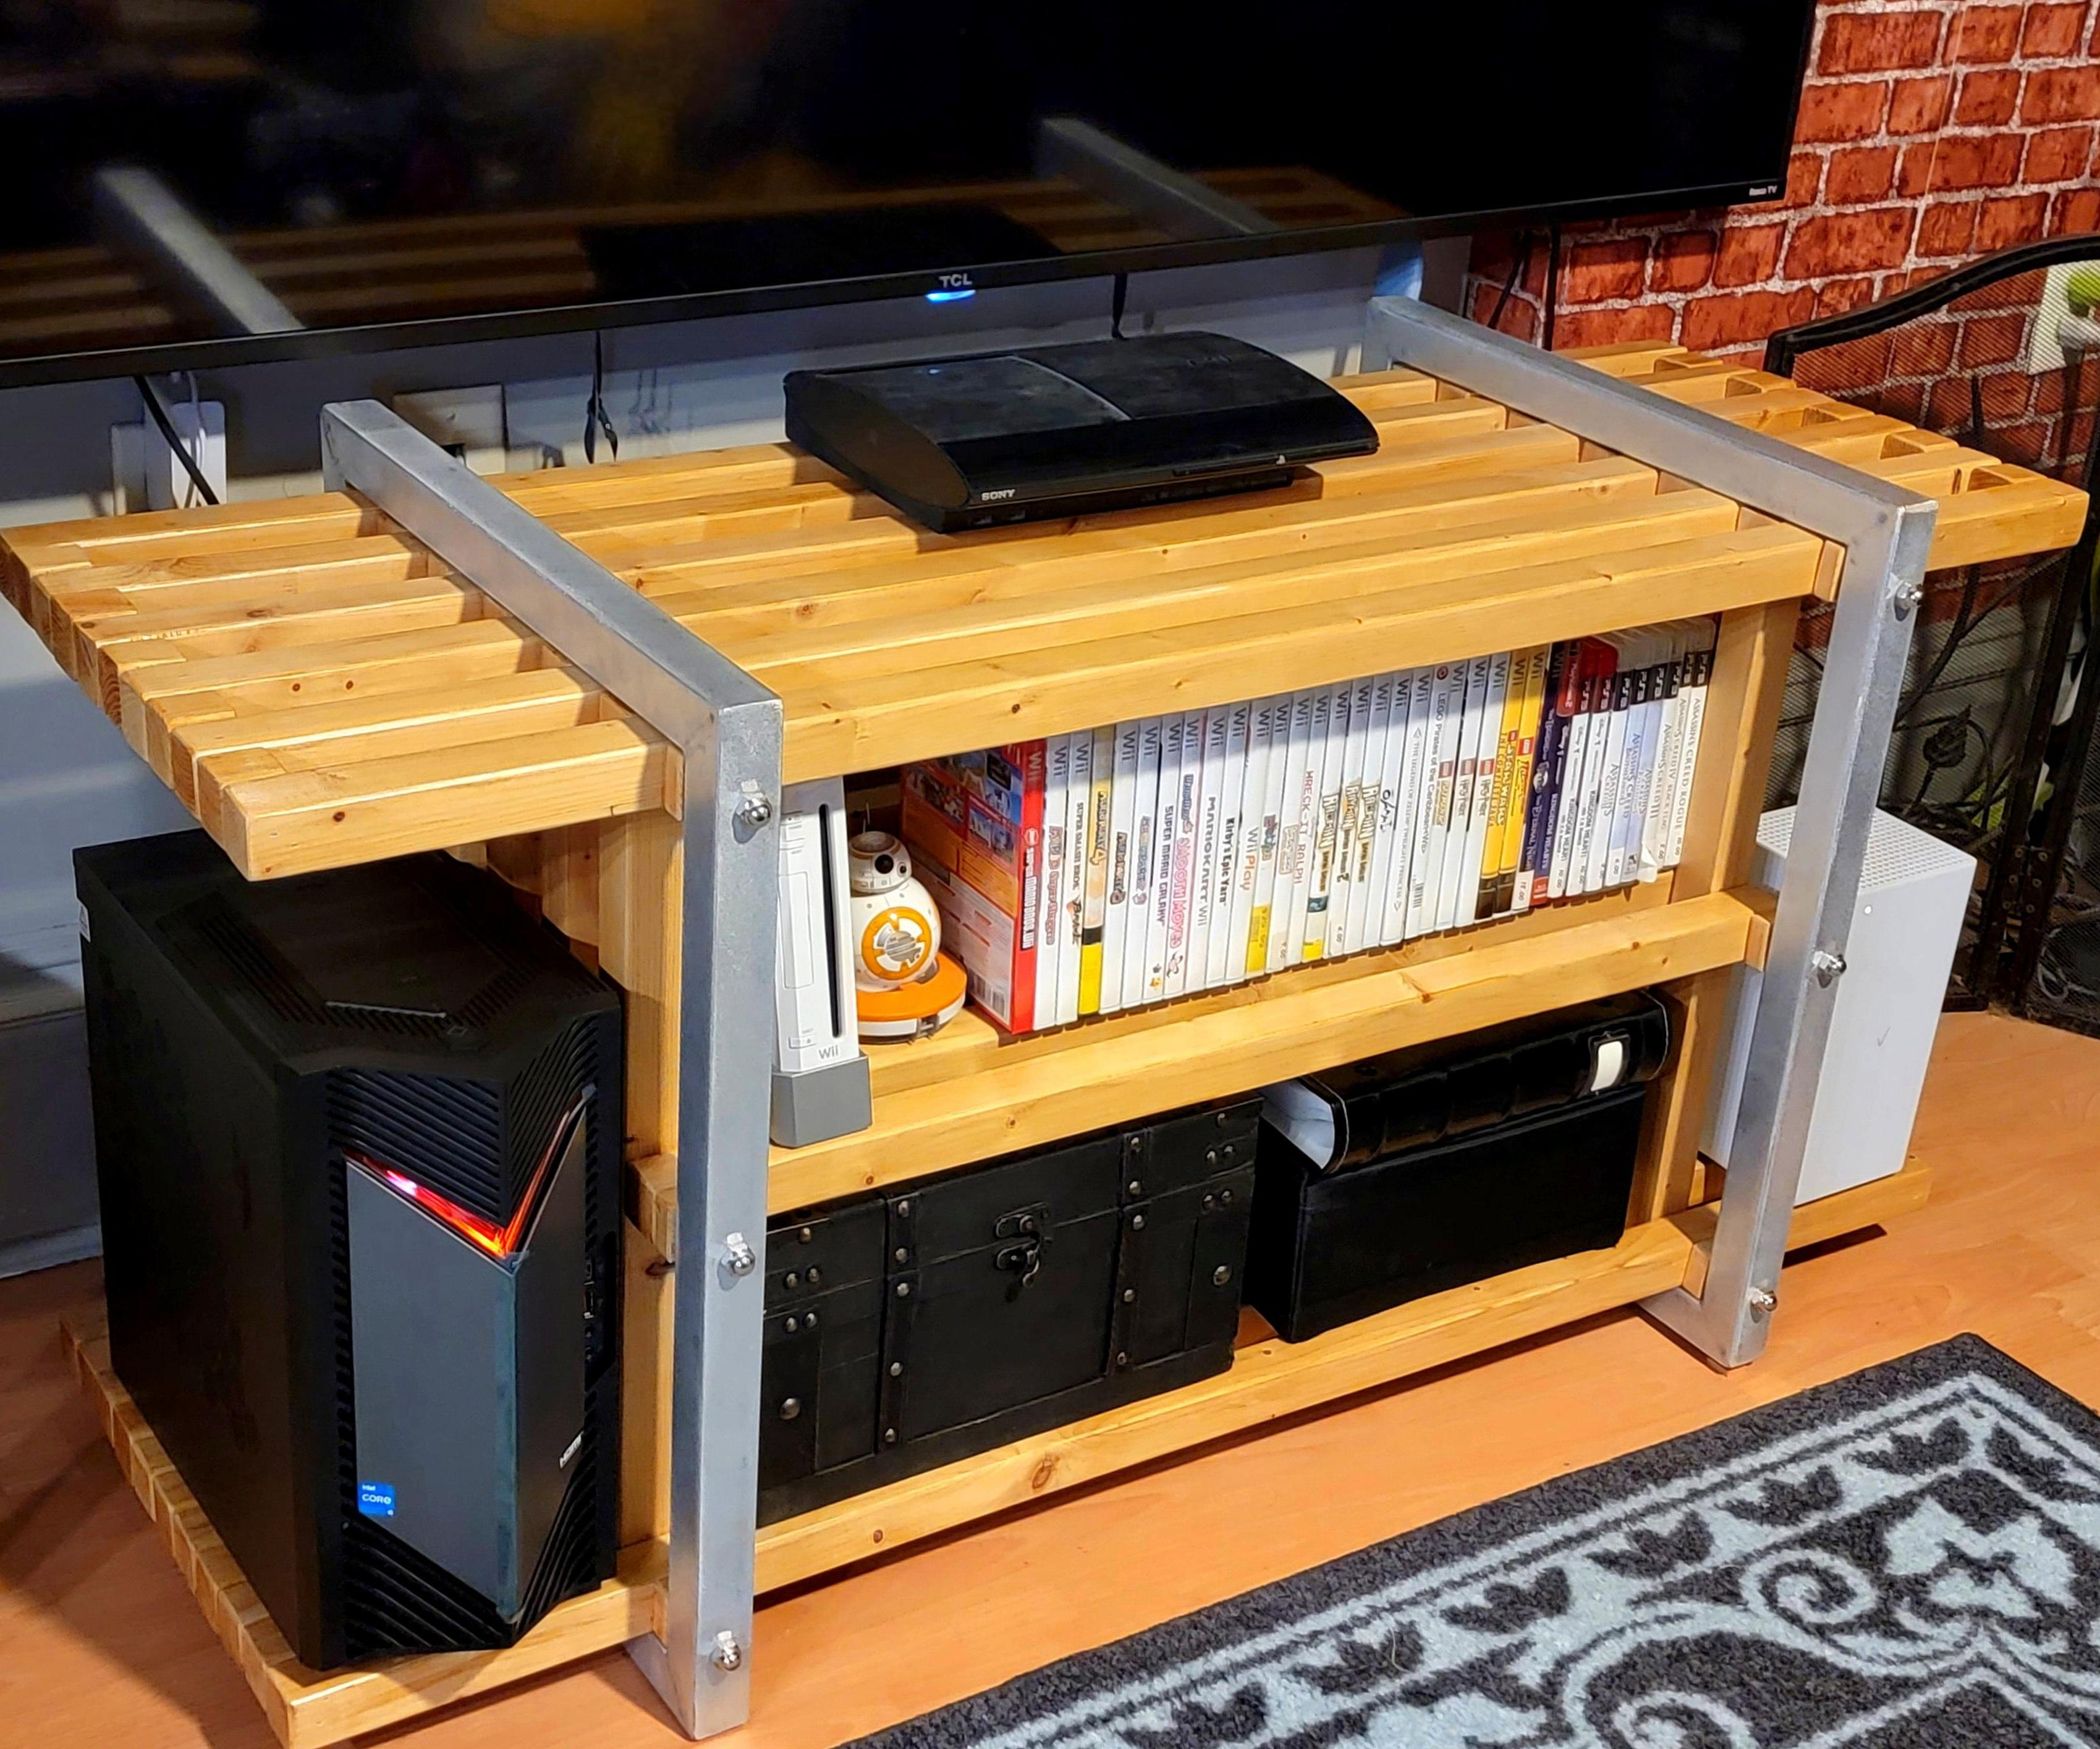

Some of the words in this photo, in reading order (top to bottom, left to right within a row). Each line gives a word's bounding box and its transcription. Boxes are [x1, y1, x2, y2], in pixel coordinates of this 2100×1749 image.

[939, 273, 973, 288] TCL
[981, 489, 1016, 501] SONY
[1450, 664, 1464, 692] Wii
[1473, 661, 1486, 688] Wii
[1493, 661, 1506, 688] Wii
[1512, 658, 1526, 686] Wii
[1531, 652, 1545, 679] Wii
[1684, 654, 1695, 684] PS3
[1697, 655, 1709, 684] PS3
[1395, 679, 1409, 707] Wii
[1416, 674, 1430, 703] Wii
[1600, 679, 1611, 710] PS3
[1620, 678, 1631, 709] PS3
[1637, 671, 1647, 701] PS3
[1654, 668, 1665, 698] PS3
[1671, 666, 1680, 695] PS3
[1314, 695, 1328, 724] Wii
[1336, 691, 1349, 719] Wii
[1356, 685, 1370, 713] Wii
[1376, 683, 1389, 711] Wii
[1436, 693, 1446, 721] LEGO
[1580, 681, 1591, 711] PS3
[1232, 707, 1246, 736] Wii
[1256, 708, 1271, 737] Wii
[1275, 704, 1288, 732] Wii
[1296, 698, 1309, 726] Wii
[1122, 731, 1136, 760] Wii
[1144, 726, 1158, 755] Wii
[1168, 723, 1180, 752] Wii
[1185, 719, 1198, 748] Wii
[1211, 717, 1224, 746] Wii
[1432, 723, 1442, 755] Pirates
[1028, 751, 1042, 779] Wii
[1053, 746, 1067, 776] Wii
[1075, 743, 1089, 773] Wii
[1682, 748, 1694, 787] CREED
[1076, 802, 1084, 829] SUPER
[1300, 770, 1314, 835] WRECK-IT
[1546, 793, 1558, 835] KINGDOM
[1675, 790, 1688, 829] ROGUE
[1162, 805, 1174, 841] SUPER
[1222, 817, 1235, 853] Kirby's
[1529, 806, 1542, 846] ETERNAL
[1074, 832, 1082, 862] SMASH
[1160, 844, 1171, 879] MARIO
[1541, 836, 1553, 869] HEARTS
[1221, 854, 1232, 878] Epic
[1293, 844, 1306, 885] RALPH
[1157, 882, 1168, 923] GALAXY
[1219, 879, 1230, 904] Yarn
[1197, 906, 1208, 926] Wii
[819, 1044, 839, 1059] Wii
